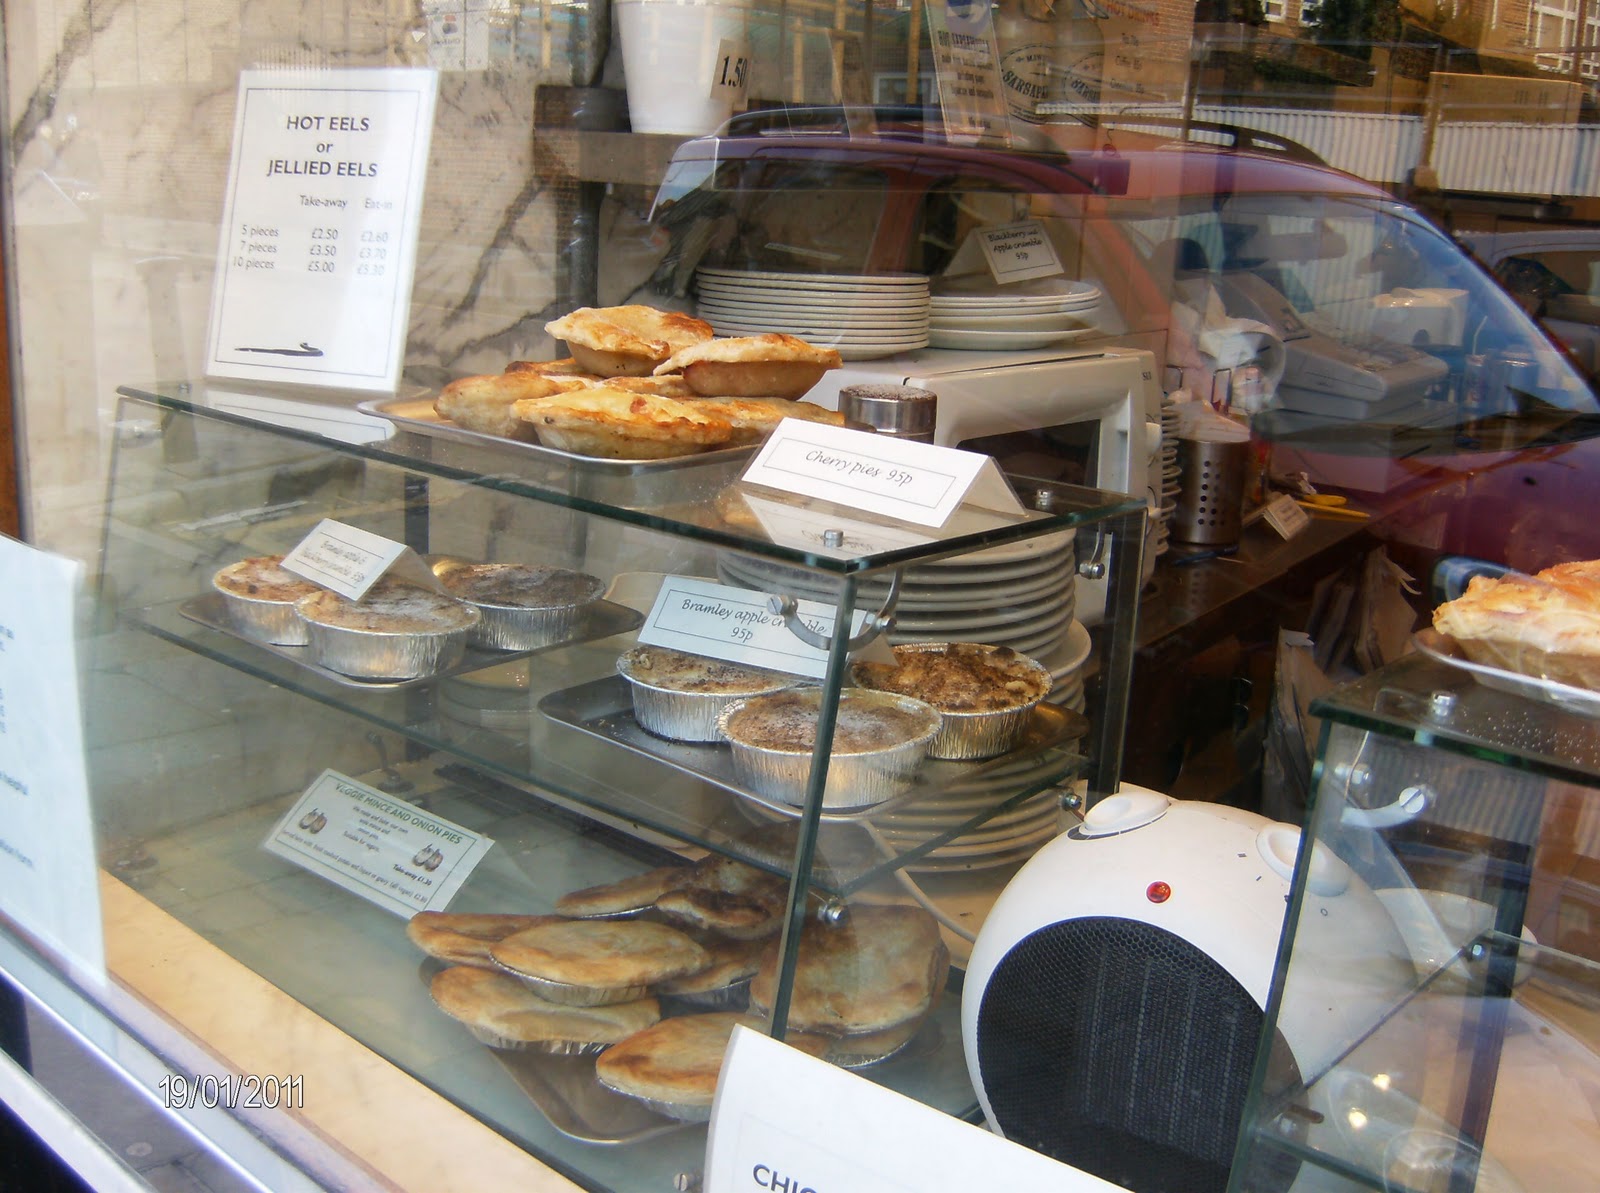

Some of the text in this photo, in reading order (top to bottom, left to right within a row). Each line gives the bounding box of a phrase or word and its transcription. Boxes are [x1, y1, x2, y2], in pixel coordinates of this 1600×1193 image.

[719, 56, 748, 88] 1.50
[287, 115, 370, 132] HOT EELS
[316, 142, 334, 153] or
[266, 159, 378, 177] JELLIED EELS
[300, 195, 348, 211] Take-away
[242, 224, 247, 235] 5
[250, 224, 279, 238] pieces
[312, 228, 338, 241] £2.50
[240, 240, 246, 250] 7
[249, 241, 277, 254] pieces
[310, 245, 336, 256] £3.50
[993, 244, 1013, 254] Apple
[233, 256, 244, 267] 10
[245, 257, 274, 271] pieces
[308, 261, 335, 273] £5.00
[805, 449, 913, 487] Cherry pies 95p
[681, 598, 828, 634] Bramley apple crble
[730, 627, 754, 643] 95p
[335, 782, 464, 845] VEGGIE MINCE AND ONION PIES
[753, 1163, 818, 1193] CHI
